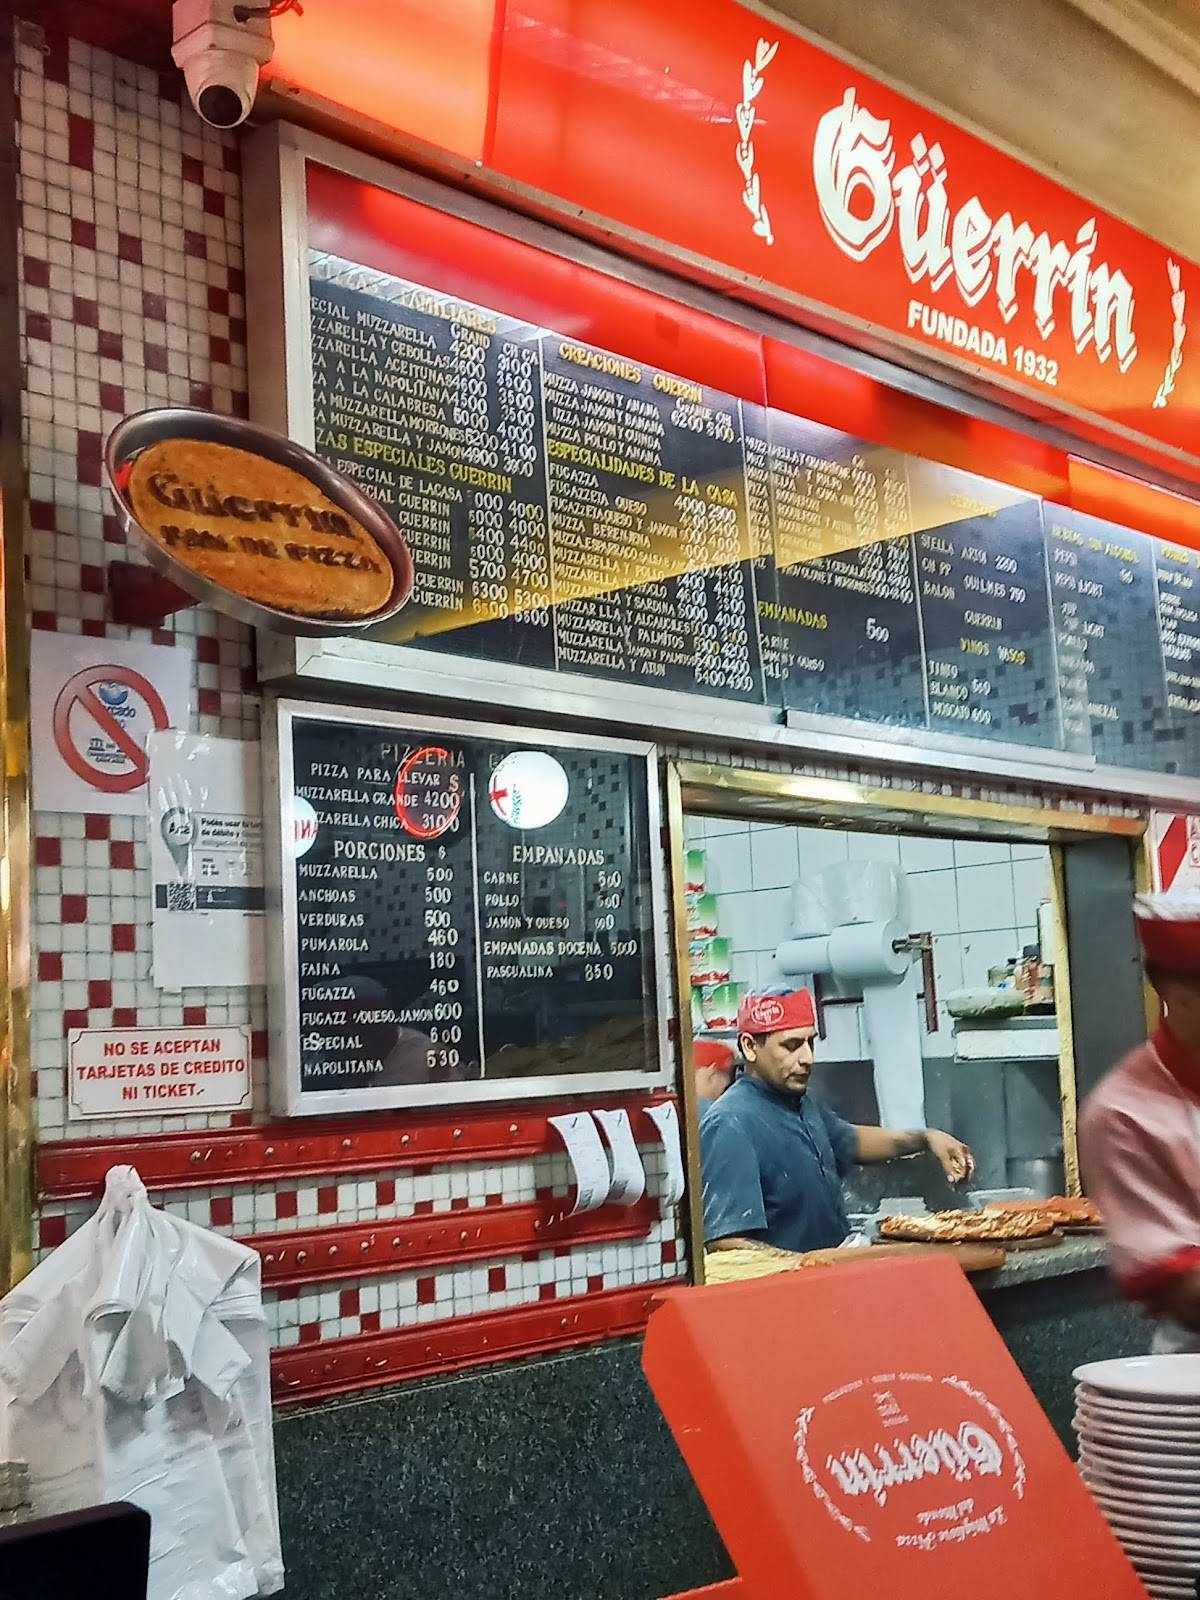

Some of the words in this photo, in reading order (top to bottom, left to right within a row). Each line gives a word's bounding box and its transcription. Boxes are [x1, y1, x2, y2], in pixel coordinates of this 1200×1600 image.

[356, 311, 437, 350] MUZZARELLA
[450, 339, 486, 363] 4200
[908, 300, 1007, 366] FUNDADA
[1014, 345, 1058, 386] 1932
[352, 363, 369, 382] LA
[560, 343, 642, 384] CREACIONES
[497, 371, 532, 395] 3500
[353, 381, 369, 400] LA
[374, 386, 447, 421] CALABRESA
[496, 420, 532, 444] 4000
[330, 394, 408, 430] MUZZARELLA
[501, 440, 537, 460] 4100
[330, 410, 412, 446] MUZZARELLA
[354, 437, 446, 476] ESPECIALES
[450, 463, 513, 494] GUERRIN
[548, 439, 655, 484] ESPECIALIDADES
[658, 470, 676, 490] DE
[681, 476, 699, 497] LA
[706, 484, 738, 506] CASA
[550, 462, 600, 488] FUGAZZA
[399, 475, 413, 489] DE
[508, 500, 544, 522] 4000
[399, 493, 450, 516] GUERRIN
[509, 518, 546, 539] 4000
[399, 511, 451, 534] GUERRIN
[510, 534, 545, 555] 4400
[511, 553, 548, 573] 4000
[553, 545, 620, 571] MUZZARELLA
[415, 572, 464, 593] GUERRIN
[472, 581, 508, 601] 6300
[469, 560, 506, 580] 5700
[511, 569, 549, 589] 4700
[411, 585, 464, 611] GUERRIN
[559, 646, 625, 671] MUZZARELLA
[311, 763, 349, 779] PIZZA
[357, 767, 391, 782] PARA
[398, 771, 441, 787] LLEVAR
[296, 786, 370, 803] MUZZARELLA
[424, 791, 460, 809] 4200
[334, 840, 426, 862] PORCIONES
[512, 845, 605, 866] EMPANADAS
[299, 864, 378, 880] MUZZARELLA
[427, 868, 453, 881] 500
[484, 871, 520, 884] CARNE
[299, 889, 356, 902] ANCHOAS
[425, 887, 452, 903] 500
[485, 894, 519, 907] POLLO
[300, 913, 364, 927] VERDURAS
[424, 909, 451, 928] 500
[486, 917, 522, 929] JAMON
[526, 917, 534, 930] Y
[535, 916, 570, 930] QUESO
[302, 937, 369, 951] PUMAROLA
[428, 928, 458, 947] 460
[484, 941, 554, 956] EMPANADAS
[301, 963, 340, 976] FAINA
[429, 951, 456, 970] 180
[487, 965, 554, 978] PASCUALINA
[302, 986, 356, 1001] FUGAZZA
[430, 978, 459, 996] 460
[302, 1011, 347, 1026] FUGAZZ
[434, 1002, 462, 1021] 600
[104, 1042, 125, 1057] NO
[131, 1041, 149, 1055] SE
[154, 1039, 221, 1054] ACEPTAN
[303, 1031, 363, 1051] ESPECIAL
[430, 1025, 462, 1044] 600
[76, 1063, 155, 1080] TARJETAS
[160, 1063, 179, 1075] DE
[184, 1059, 245, 1074] CREDITO
[304, 1059, 384, 1076] NAPOLITANA
[426, 1049, 460, 1068] 530
[122, 1087, 138, 1100] NI
